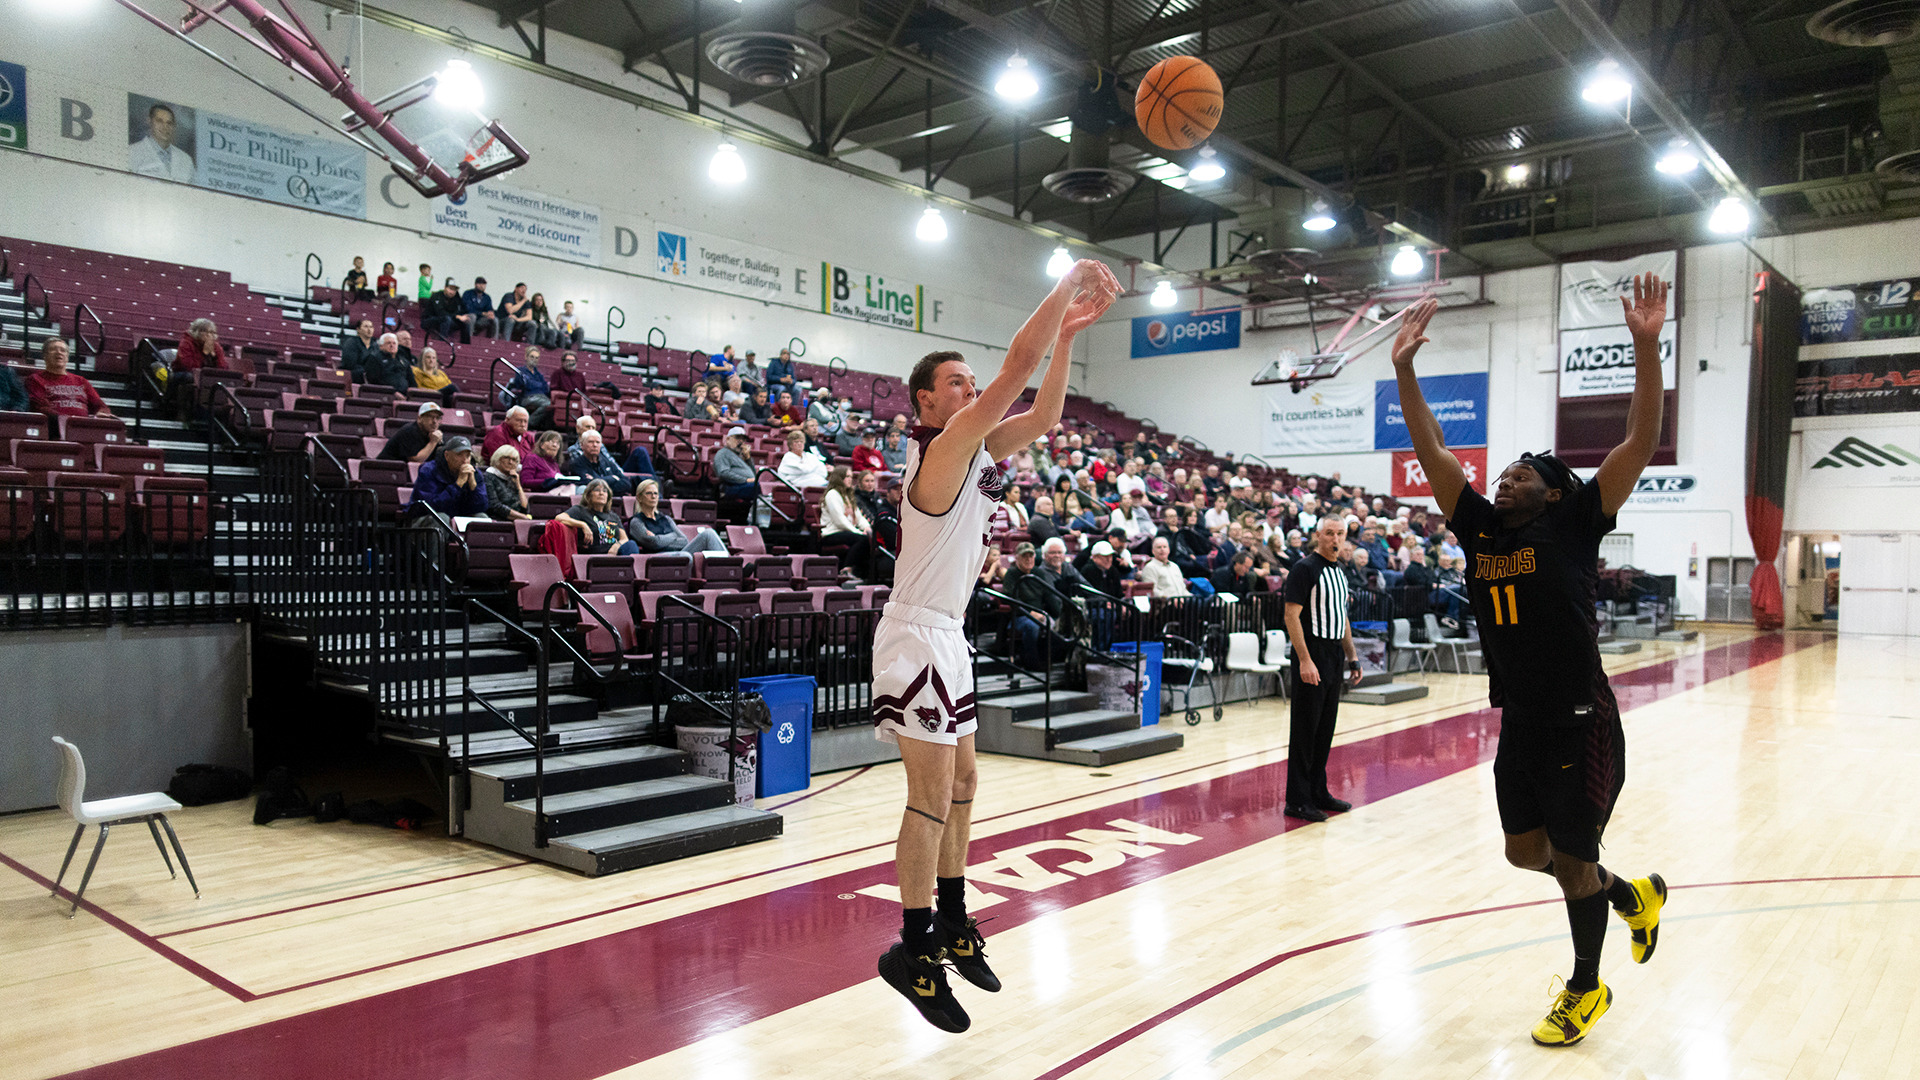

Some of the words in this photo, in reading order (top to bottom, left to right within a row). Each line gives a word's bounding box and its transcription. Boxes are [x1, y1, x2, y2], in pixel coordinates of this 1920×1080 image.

[60, 97, 94, 141] B
[209, 130, 240, 155] Dr.
[247, 140, 309, 173] Phillip
[310, 155, 361, 182] Jones
[445, 204, 468, 219] Best
[477, 184, 499, 200] Best
[501, 190, 540, 209] Western
[542, 201, 582, 220] Heritage
[582, 210, 599, 224] Inn
[435, 213, 477, 231] Western
[498, 216, 525, 233] 20%
[527, 222, 581, 246] discount
[614, 225, 639, 257] D
[700, 247, 743, 269] Together,
[744, 257, 780, 277] Building
[700, 267, 706, 276] a
[707, 265, 737, 282] Better
[739, 272, 782, 292] California
[794, 267, 807, 295] E
[833, 266, 850, 301] B
[866, 274, 914, 316] Line
[1880, 281, 1912, 306] 12
[854, 306, 889, 323] Regional
[891, 313, 914, 328] Transit
[933, 300, 943, 323] F
[1807, 310, 1848, 324] NEWS
[1172, 315, 1227, 343] pepsi
[1810, 321, 1845, 335] NOW
[1824, 388, 1901, 401] COUNTRY!
[1285, 407, 1334, 421] counties
[1336, 405, 1366, 418] bank
[1637, 495, 1687, 504] COMPANY
[1475, 547, 1537, 581] TOROS
[1489, 584, 1519, 626] 11
